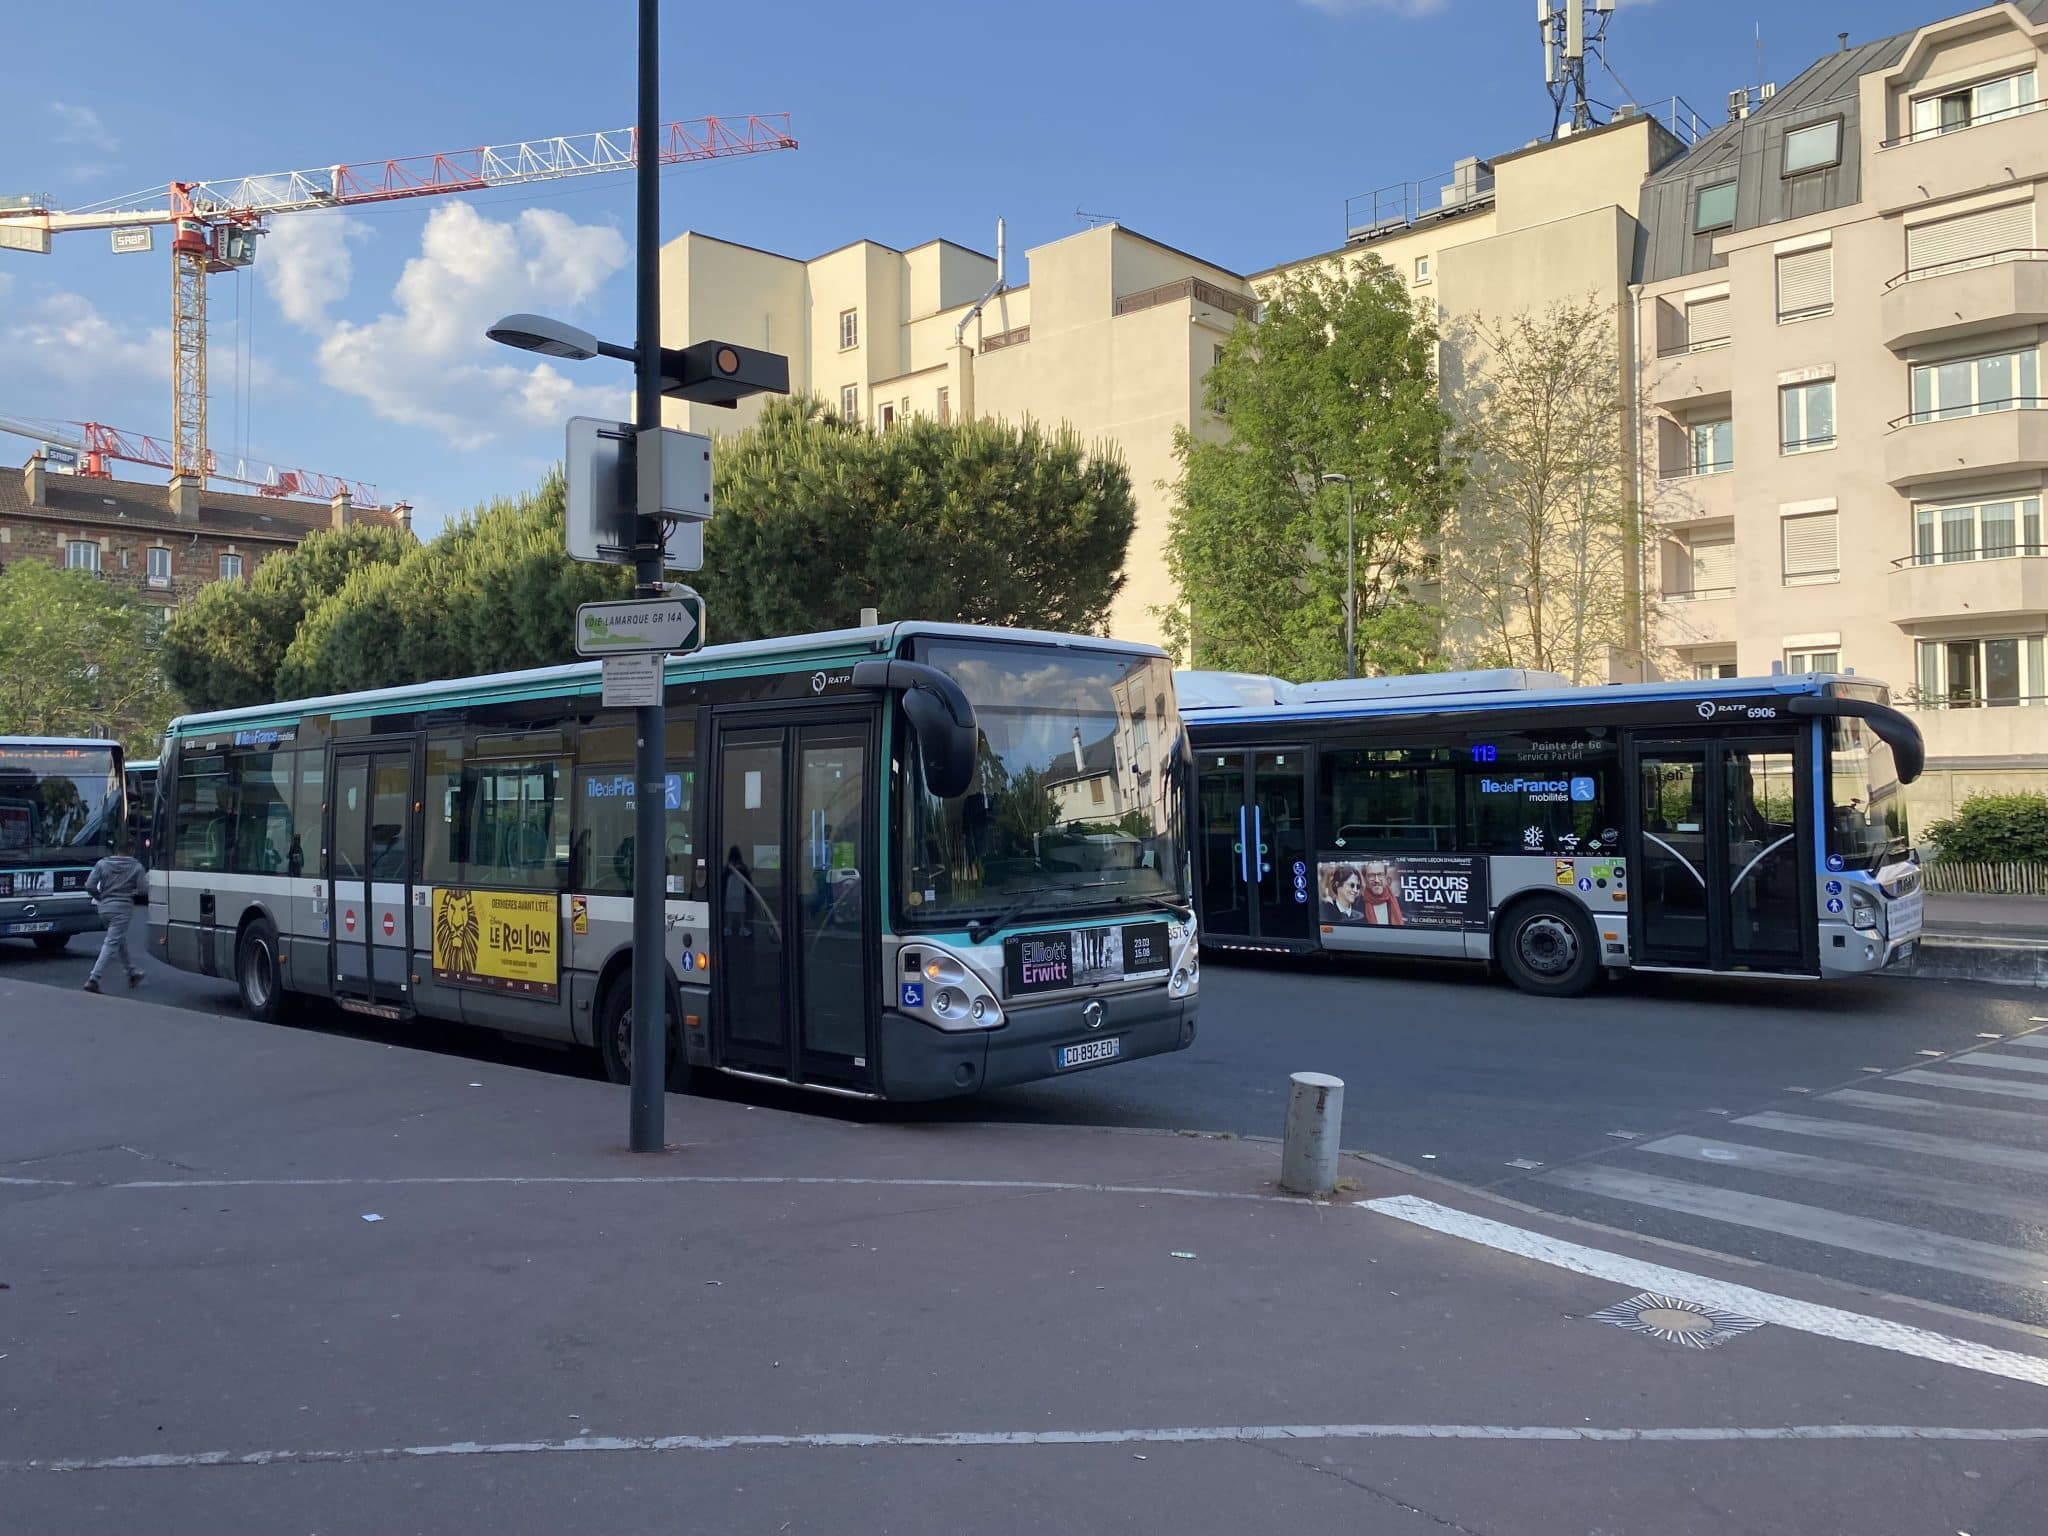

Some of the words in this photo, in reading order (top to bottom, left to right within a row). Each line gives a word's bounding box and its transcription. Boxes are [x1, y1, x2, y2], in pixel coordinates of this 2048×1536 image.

[605, 614, 649, 626] LAMARQUE
[652, 613, 664, 623] GR
[828, 675, 850, 684] RATP
[1718, 704, 1747, 712] RATP
[1747, 707, 1777, 718] 6906
[1472, 743, 1497, 762] 113
[1532, 740, 1567, 751] Pointe
[1571, 740, 1584, 750] de
[1517, 751, 1548, 761] Service
[1552, 750, 1583, 760] Partiel
[1529, 792, 1569, 802] mobilités
[1400, 876, 1418, 889] LE
[1419, 875, 1469, 890] COURS
[1404, 889, 1423, 902] DE
[1424, 890, 1444, 903] LA
[1445, 890, 1468, 904] VIE
[489, 926, 500, 944] LE
[1022, 941, 1067, 964] Elliott
[1023, 962, 1068, 984] Erwitt
